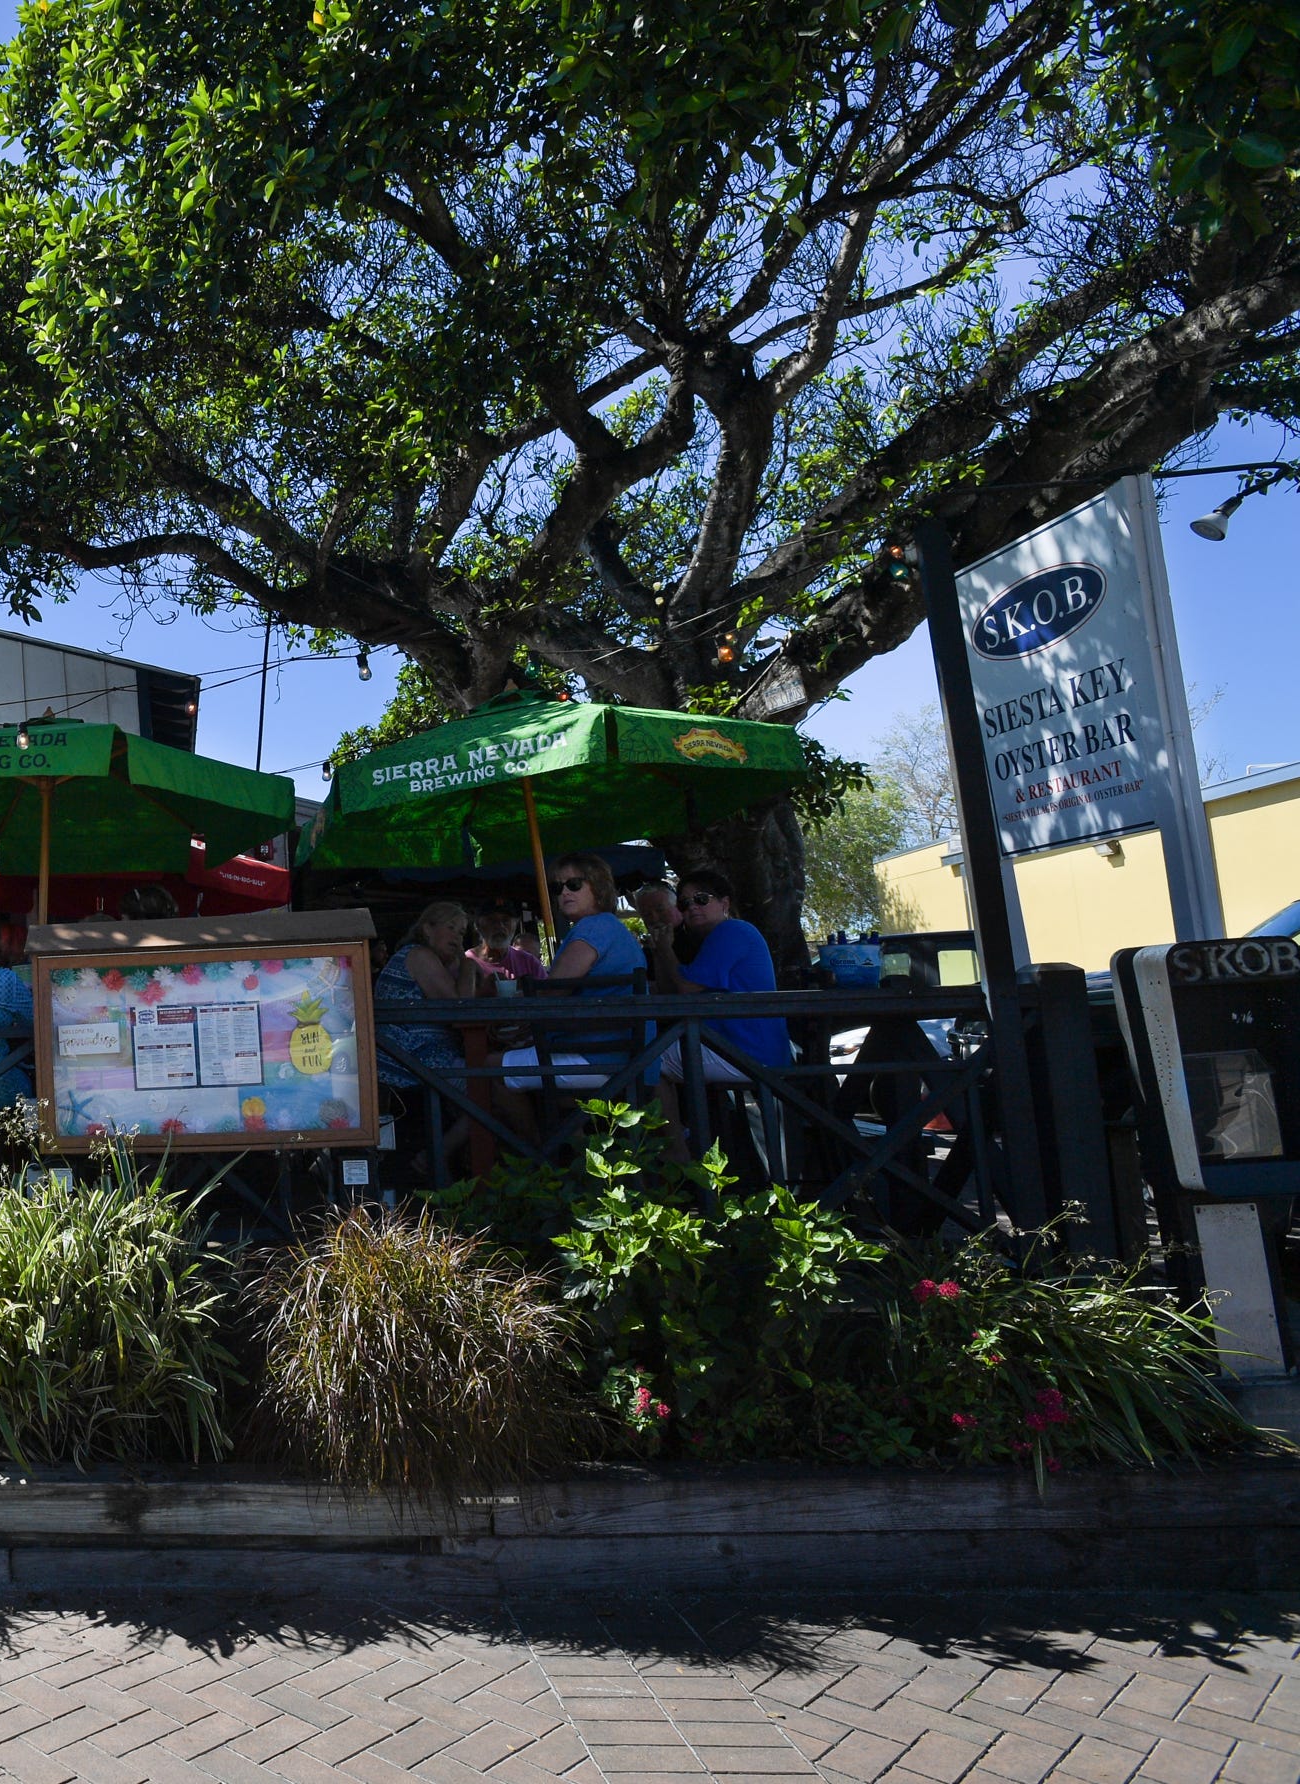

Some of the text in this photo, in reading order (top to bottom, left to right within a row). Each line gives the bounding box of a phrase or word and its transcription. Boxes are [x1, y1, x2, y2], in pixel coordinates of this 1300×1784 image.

[982, 575, 1094, 651] S.K.O.B.
[984, 658, 1127, 739] SIESTA KEY
[19, 753, 52, 770] CO.
[372, 731, 569, 786] SIERRA NEVADA
[706, 739, 733, 752] NEVADA
[994, 712, 1137, 781] OYSTER BAR
[409, 759, 532, 793] BREWING CO.
[1015, 760, 1122, 803] & RESTAURANT
[1059, 794, 1093, 811] ORIGINAL
[1094, 785, 1124, 801] OYSTER
[1173, 941, 1300, 983] SKOB
[301, 1032, 319, 1044] SUN
[302, 1054, 322, 1067] FUN
